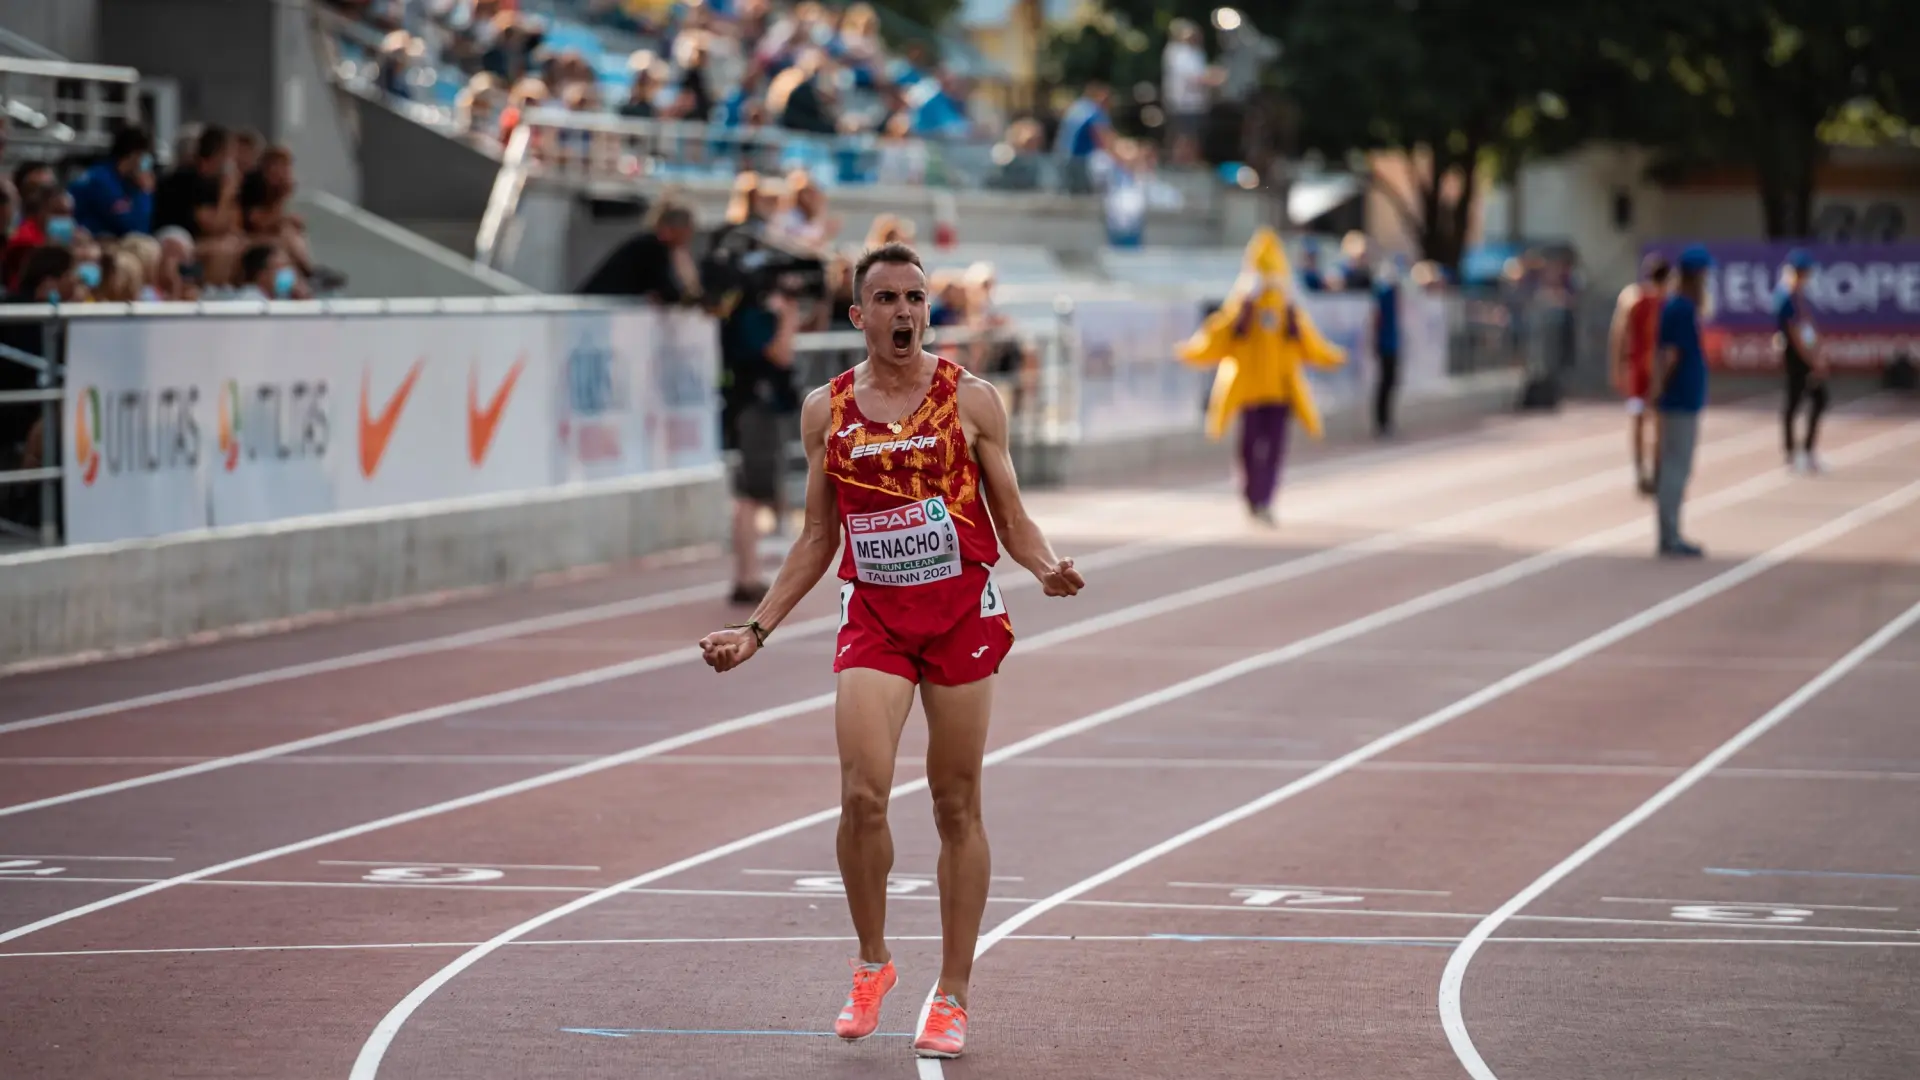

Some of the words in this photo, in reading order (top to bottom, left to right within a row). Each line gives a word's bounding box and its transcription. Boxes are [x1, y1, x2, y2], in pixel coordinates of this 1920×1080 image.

[850, 435, 937, 459] ESPAÑA
[851, 506, 924, 532] SPAR
[856, 531, 940, 559] MENACHO
[866, 571, 920, 584] TALLINN
[923, 564, 953, 581] 2021
[881, 563, 902, 571] RUN
